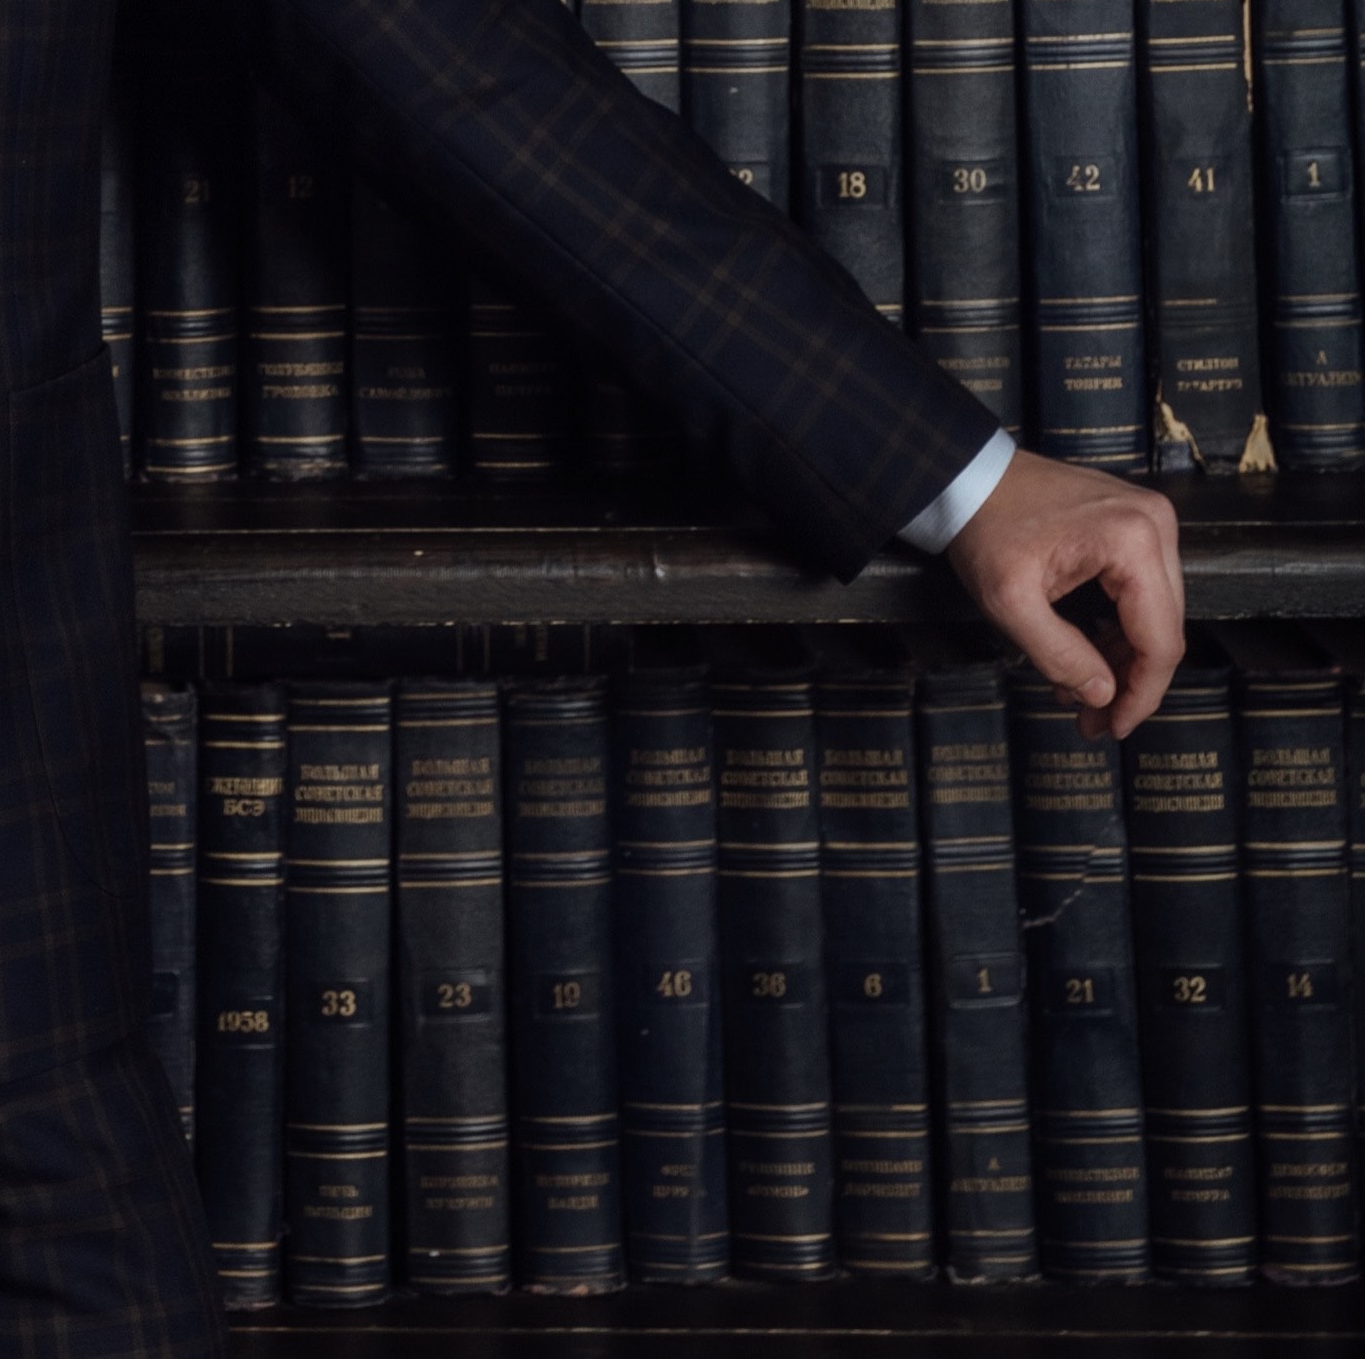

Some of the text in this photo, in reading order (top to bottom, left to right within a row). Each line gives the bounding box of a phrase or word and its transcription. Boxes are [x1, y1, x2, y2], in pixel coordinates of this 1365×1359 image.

[838, 171, 867, 199] 18
[953, 167, 988, 193] 30
[1067, 164, 1101, 192] 42
[1187, 168, 1215, 193] 41
[1308, 161, 1320, 187] 1
[287, 176, 311, 201] 12
[223, 797, 266, 816] БСЭ
[658, 969, 692, 997] 46
[754, 972, 787, 997] 36
[863, 972, 883, 998] 6
[977, 967, 991, 993] 1
[1068, 977, 1096, 1004] 21
[1175, 976, 1207, 1004] 32
[1286, 973, 1314, 999] 14
[322, 990, 357, 1017] 33
[438, 982, 473, 1008] 23
[552, 981, 583, 1009] 19
[219, 1010, 269, 1032] 1958
